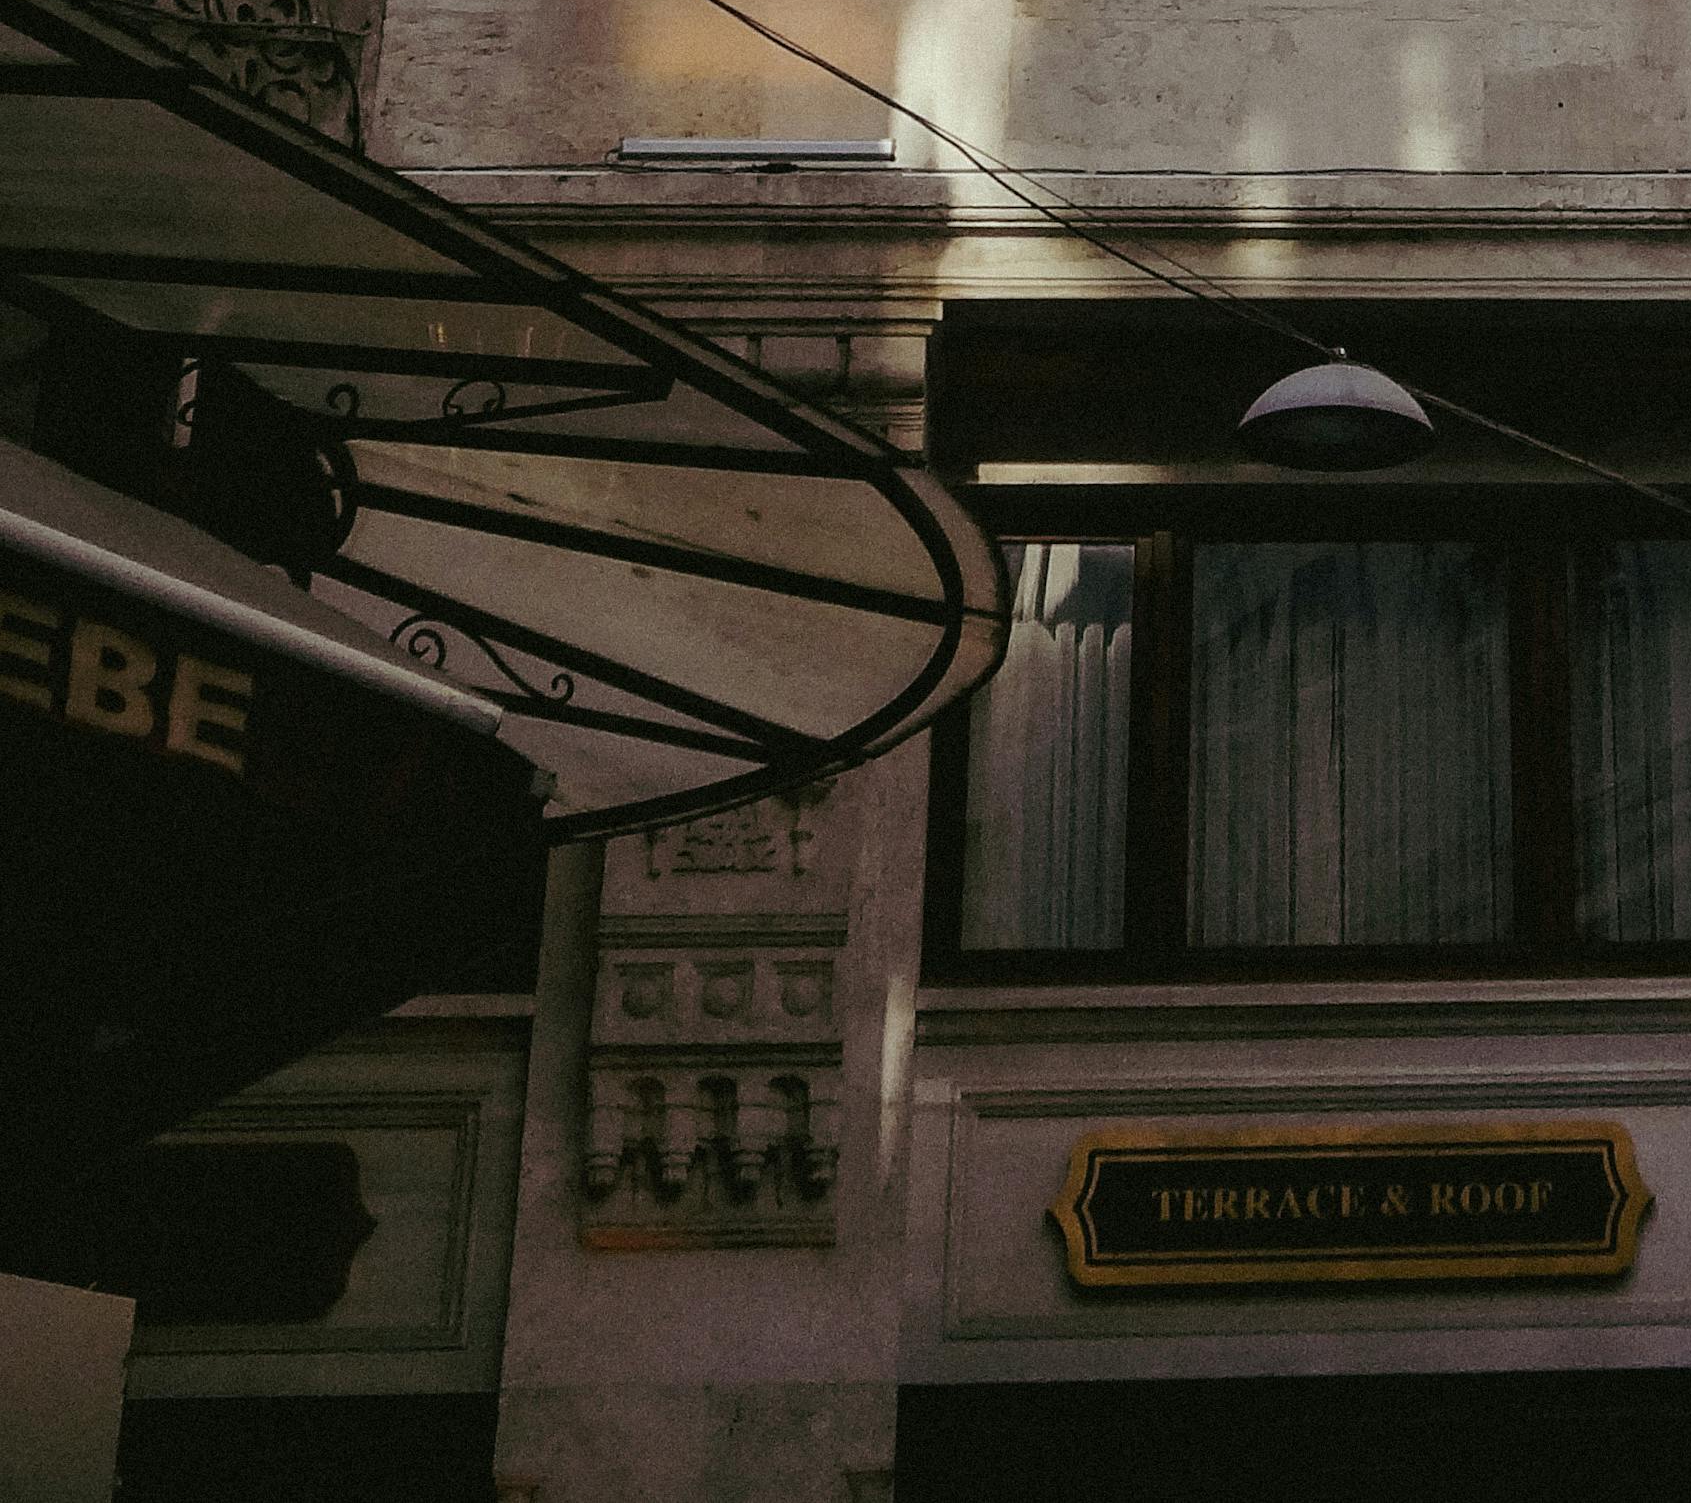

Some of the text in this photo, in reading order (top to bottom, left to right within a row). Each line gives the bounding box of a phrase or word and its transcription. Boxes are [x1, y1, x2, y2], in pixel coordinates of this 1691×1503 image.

[1152, 1180, 1553, 1222] TERRACE & ROOF
